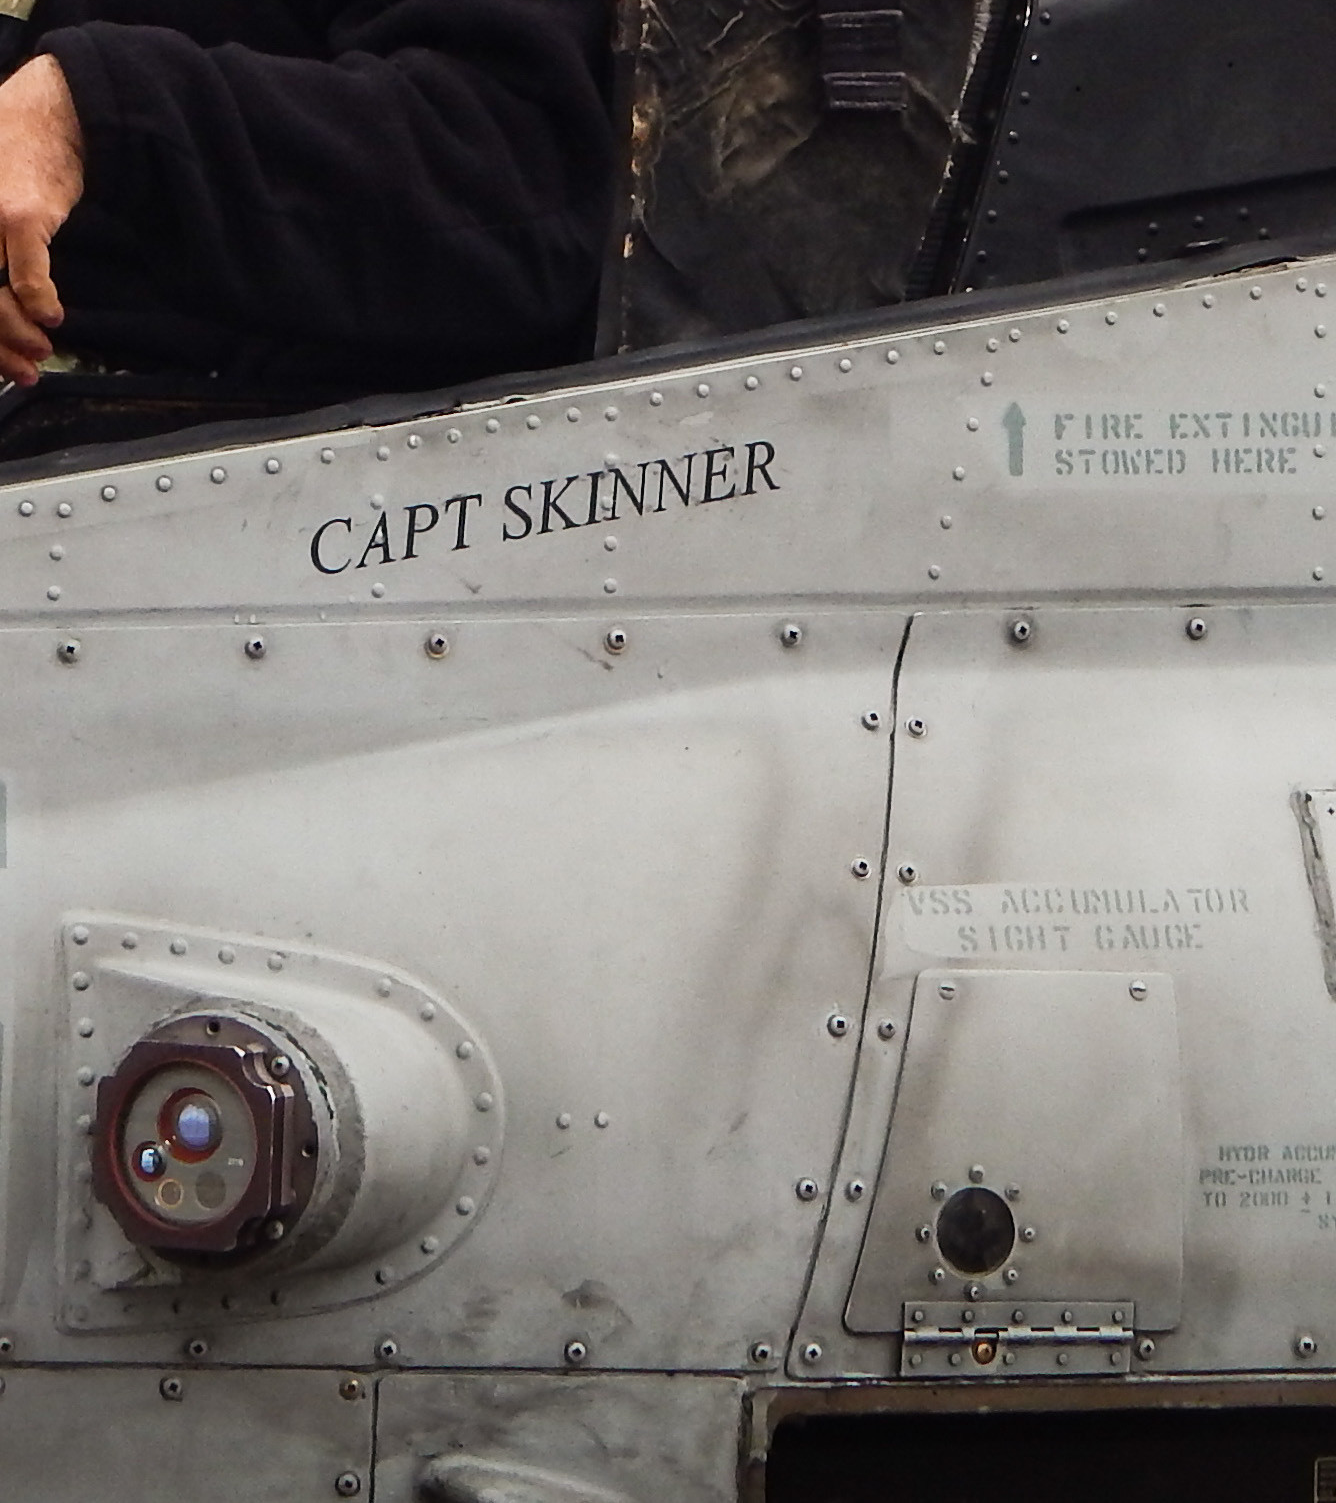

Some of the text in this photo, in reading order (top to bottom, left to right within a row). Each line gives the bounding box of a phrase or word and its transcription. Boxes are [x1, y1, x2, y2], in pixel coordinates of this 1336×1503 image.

[1054, 412, 1144, 441] FIRE
[1054, 448, 1299, 478] STOWED HERE
[309, 440, 781, 575] CAPT SKINNER
[1001, 887, 1249, 915] ACCUMULATOR
[957, 923, 1204, 952] SIGHT GAUGE
[1217, 1144, 1270, 1162] HYDR
[1198, 1168, 1322, 1185] PRE-CHARGE
[1203, 1191, 1227, 1208] TO
